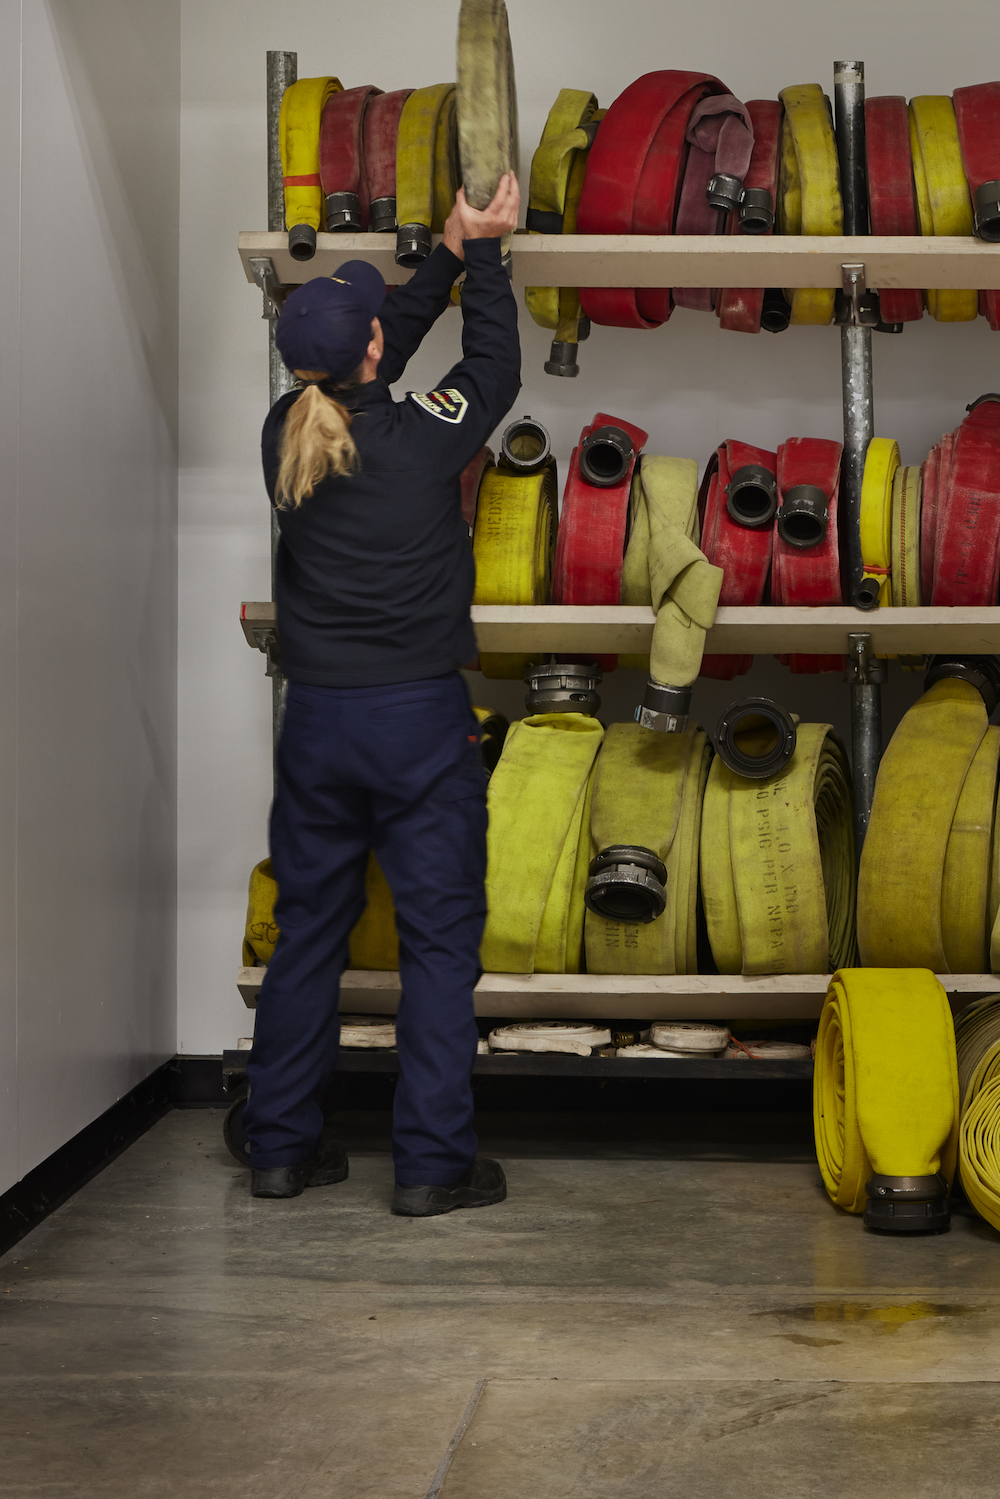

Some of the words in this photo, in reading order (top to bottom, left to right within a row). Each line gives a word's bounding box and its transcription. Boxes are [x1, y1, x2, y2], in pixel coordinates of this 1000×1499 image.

[486, 480, 504, 542] NIEDNER
[756, 808, 774, 851] PSIG
[762, 860, 778, 894] PER
[780, 863, 794, 873] X
[767, 905, 784, 949] NFPA
